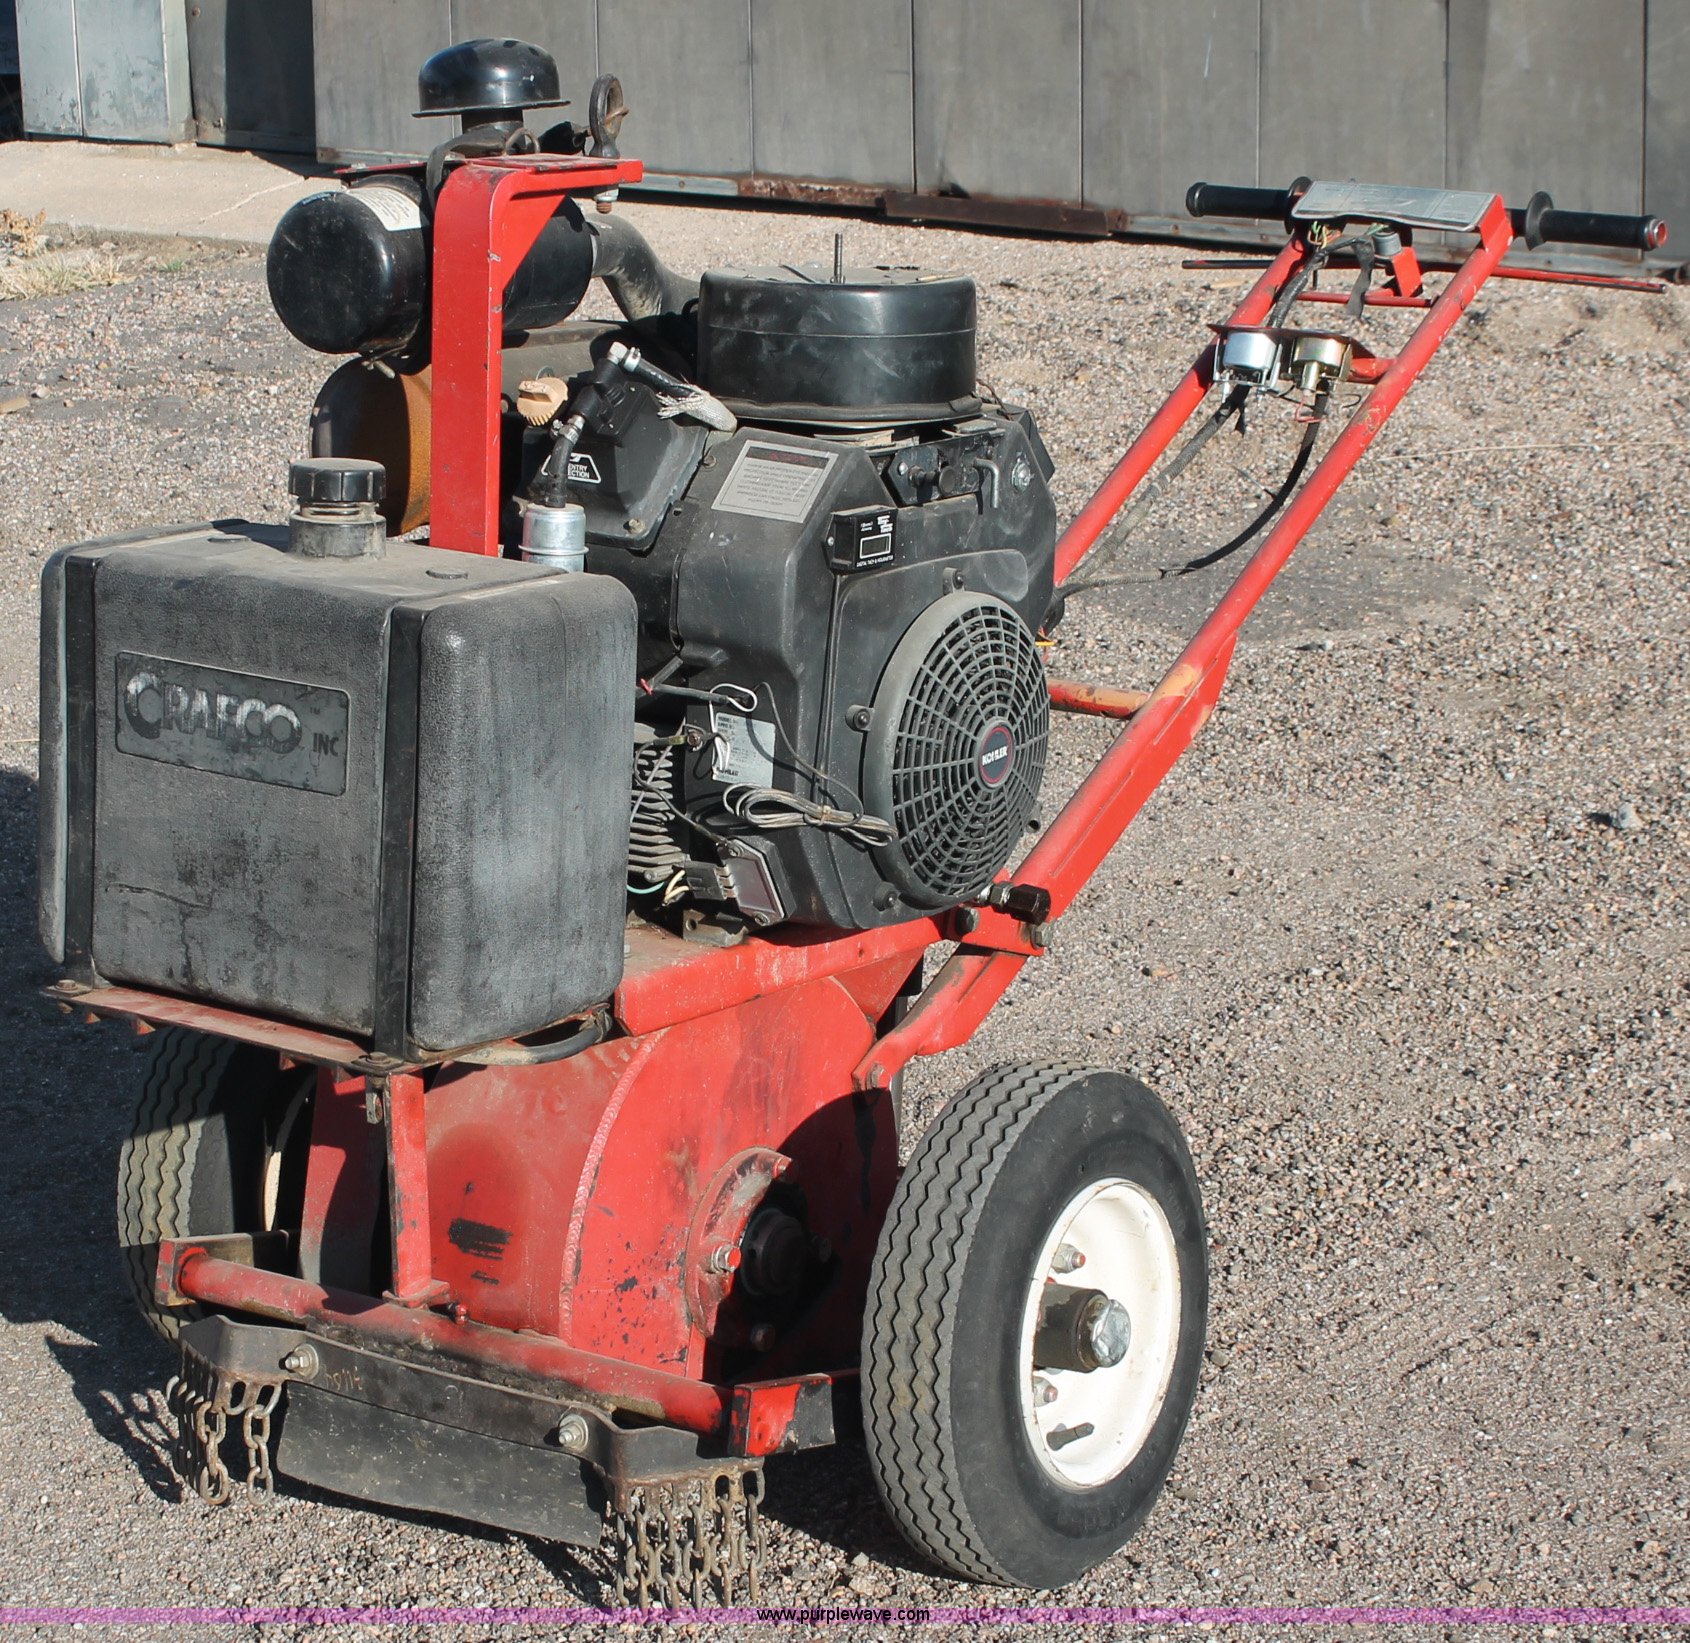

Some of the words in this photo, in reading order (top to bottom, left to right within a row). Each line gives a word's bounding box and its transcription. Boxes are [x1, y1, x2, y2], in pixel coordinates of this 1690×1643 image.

[568, 463, 588, 471] ENTRY
[124, 672, 302, 754] CRAFCO
[312, 732, 340, 757] INC
[982, 745, 1008, 766] KOHLER
